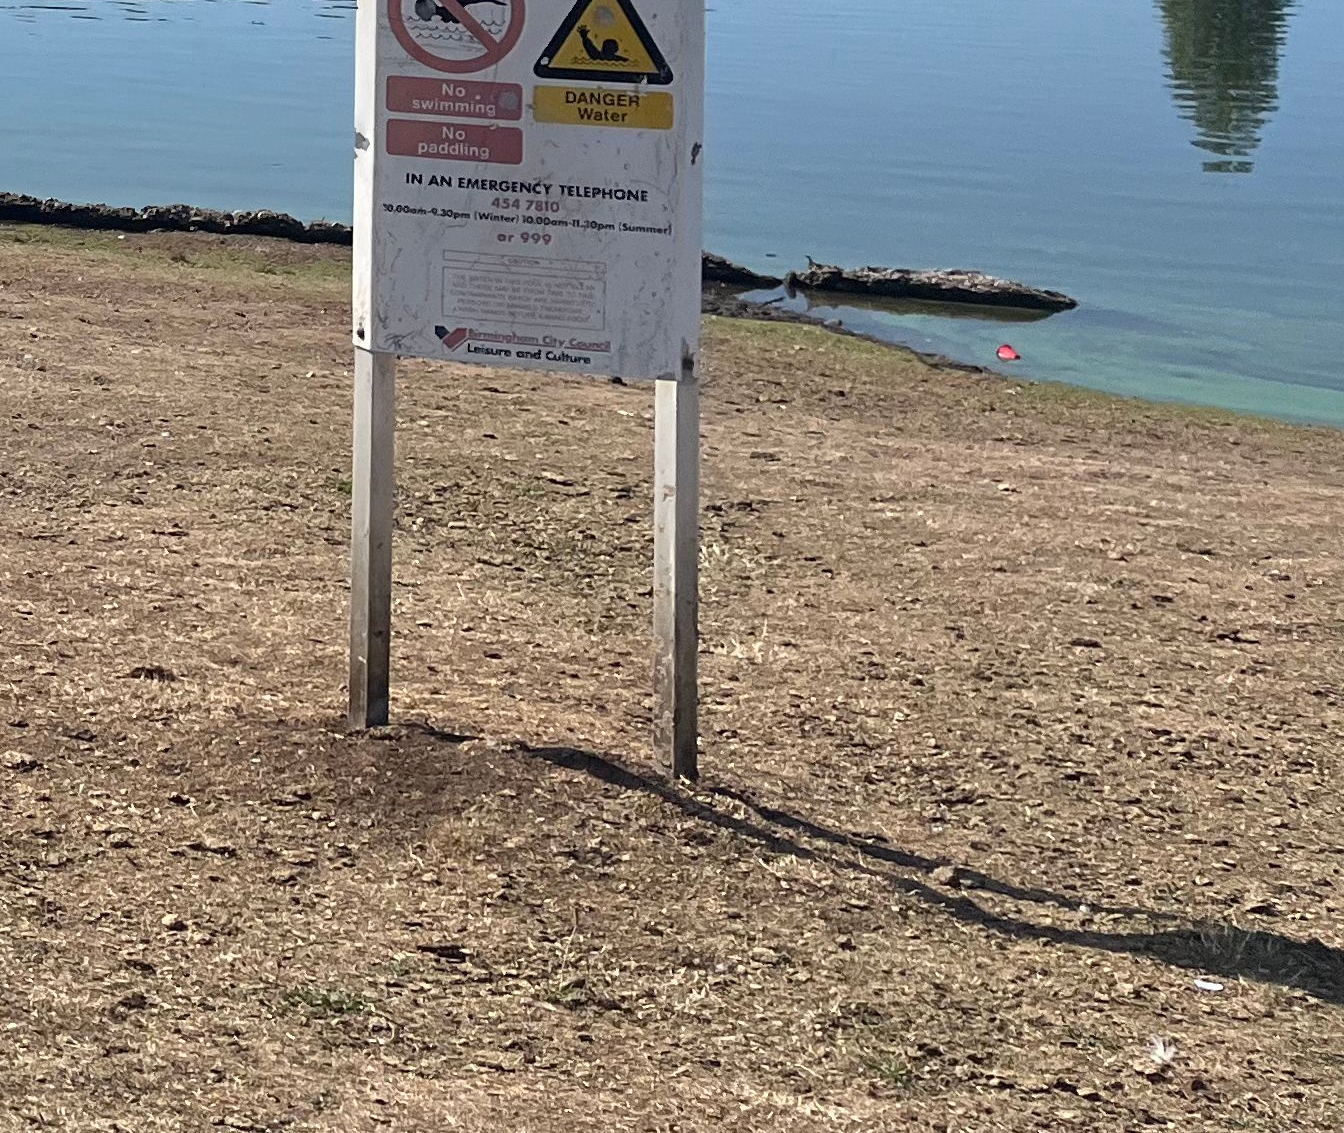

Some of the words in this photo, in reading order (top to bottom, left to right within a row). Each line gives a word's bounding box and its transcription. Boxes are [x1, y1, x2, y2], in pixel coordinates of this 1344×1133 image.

[442, 83, 466, 97] No
[565, 91, 640, 107] DANGER
[412, 98, 496, 117] swimming
[577, 107, 628, 122] Water
[442, 126, 466, 140] No
[418, 142, 490, 159] paddling
[406, 173, 423, 185] IN
[428, 175, 452, 187] AN
[458, 177, 552, 195] EMERGENCY
[559, 184, 649, 202] TELEPHONE
[492, 197, 520, 210] 454
[526, 200, 560, 213] 7810
[474, 211, 519, 224] (Winter)
[618, 221, 672, 236] (Summer)
[497, 233, 515, 243] or
[520, 232, 552, 245] 999
[468, 328, 539, 345] Birmingham
[542, 335, 566, 348] City
[568, 337, 611, 350] Council
[467, 342, 512, 357] Leisure
[516, 349, 542, 360] and
[545, 351, 591, 364] Culture
